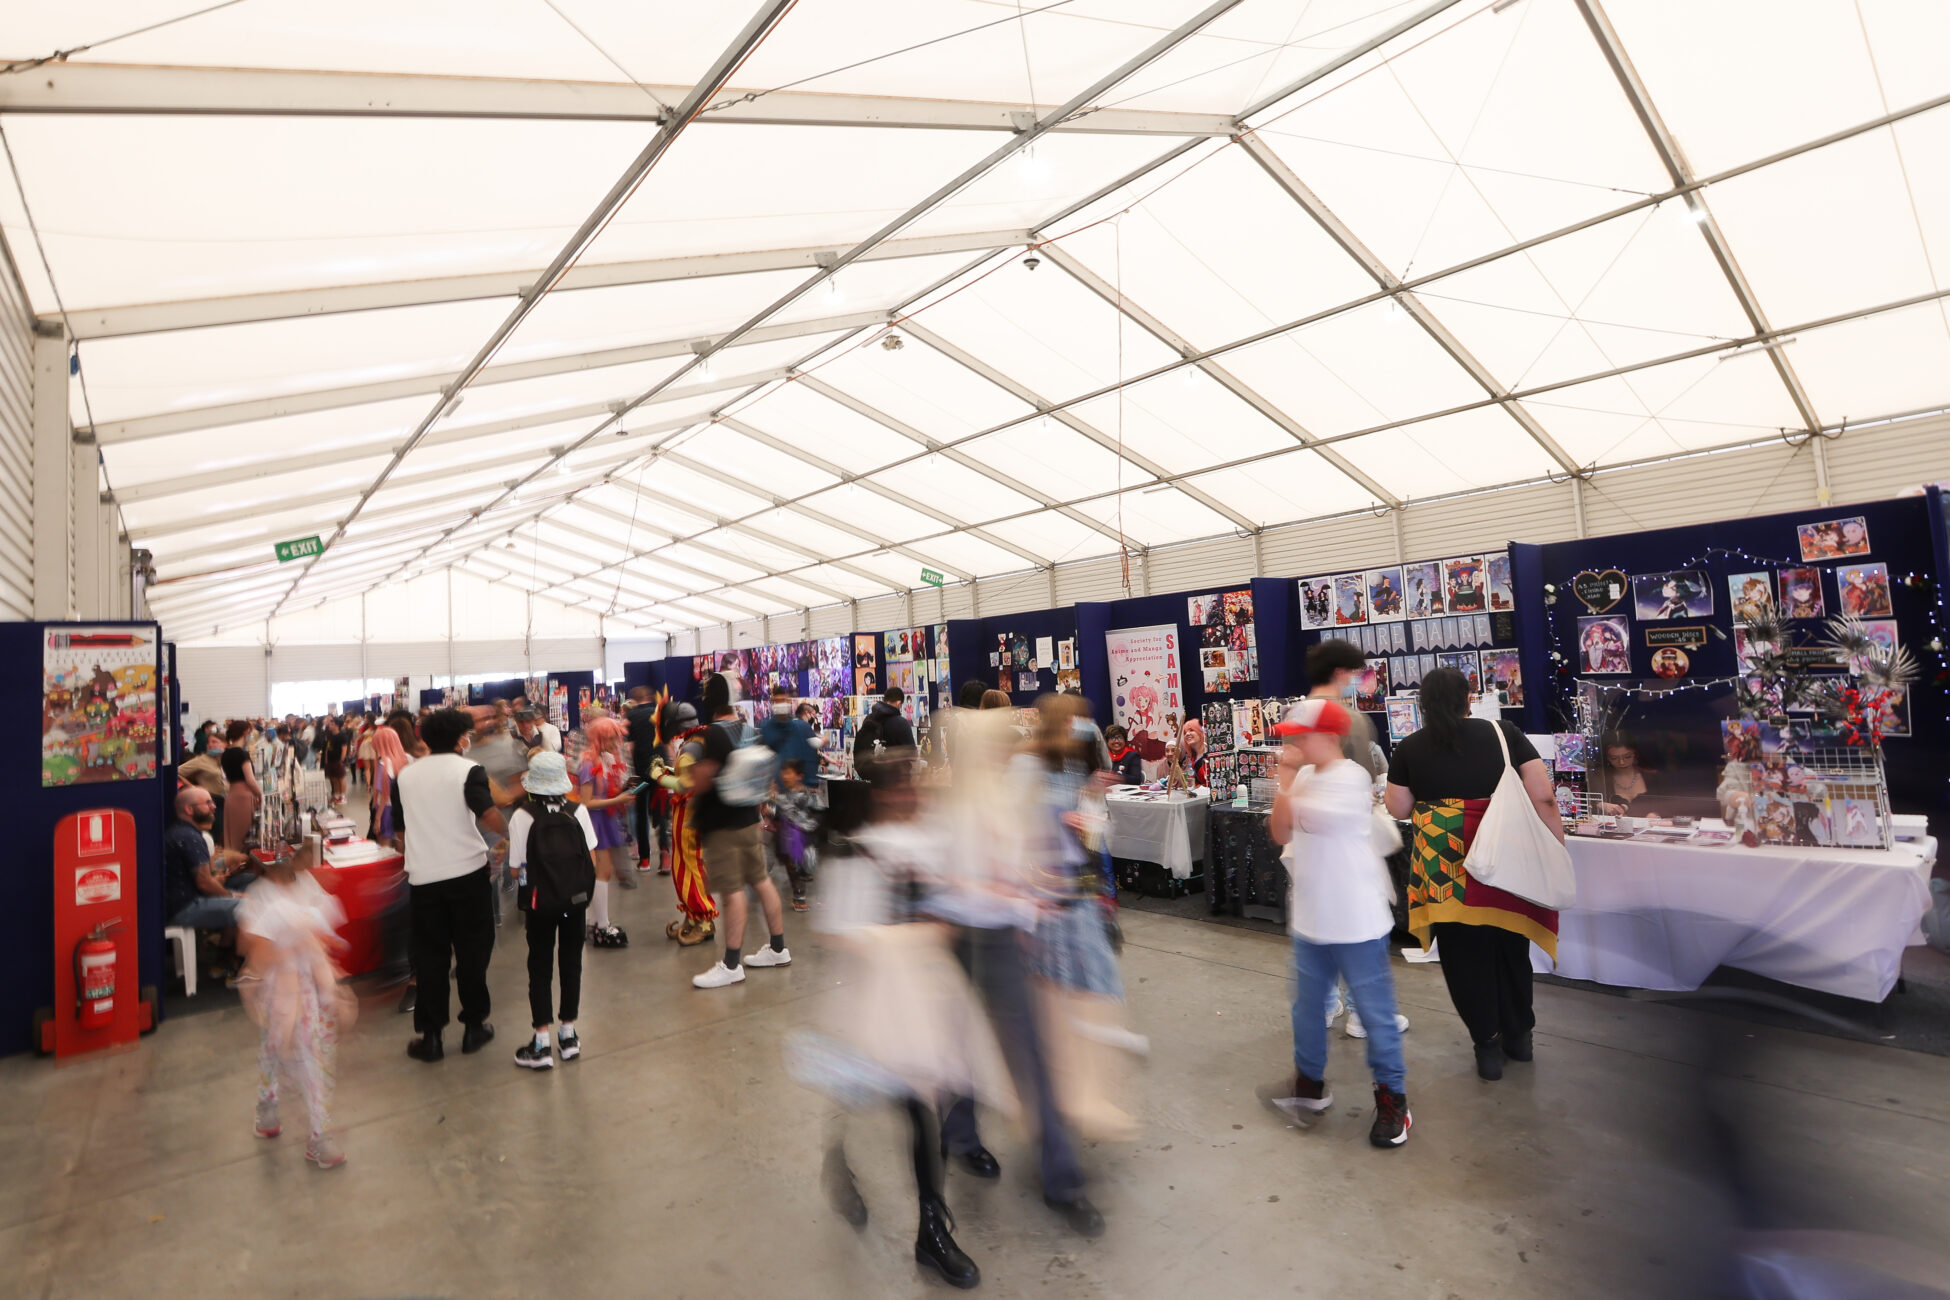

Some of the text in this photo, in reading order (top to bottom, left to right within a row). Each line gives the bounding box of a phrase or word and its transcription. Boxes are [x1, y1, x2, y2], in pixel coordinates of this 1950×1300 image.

[290, 540, 318, 557] EXIT
[926, 572, 940, 584] EXIT
[1414, 617, 1488, 642] BAIRE
[1393, 657, 1432, 677] ART
